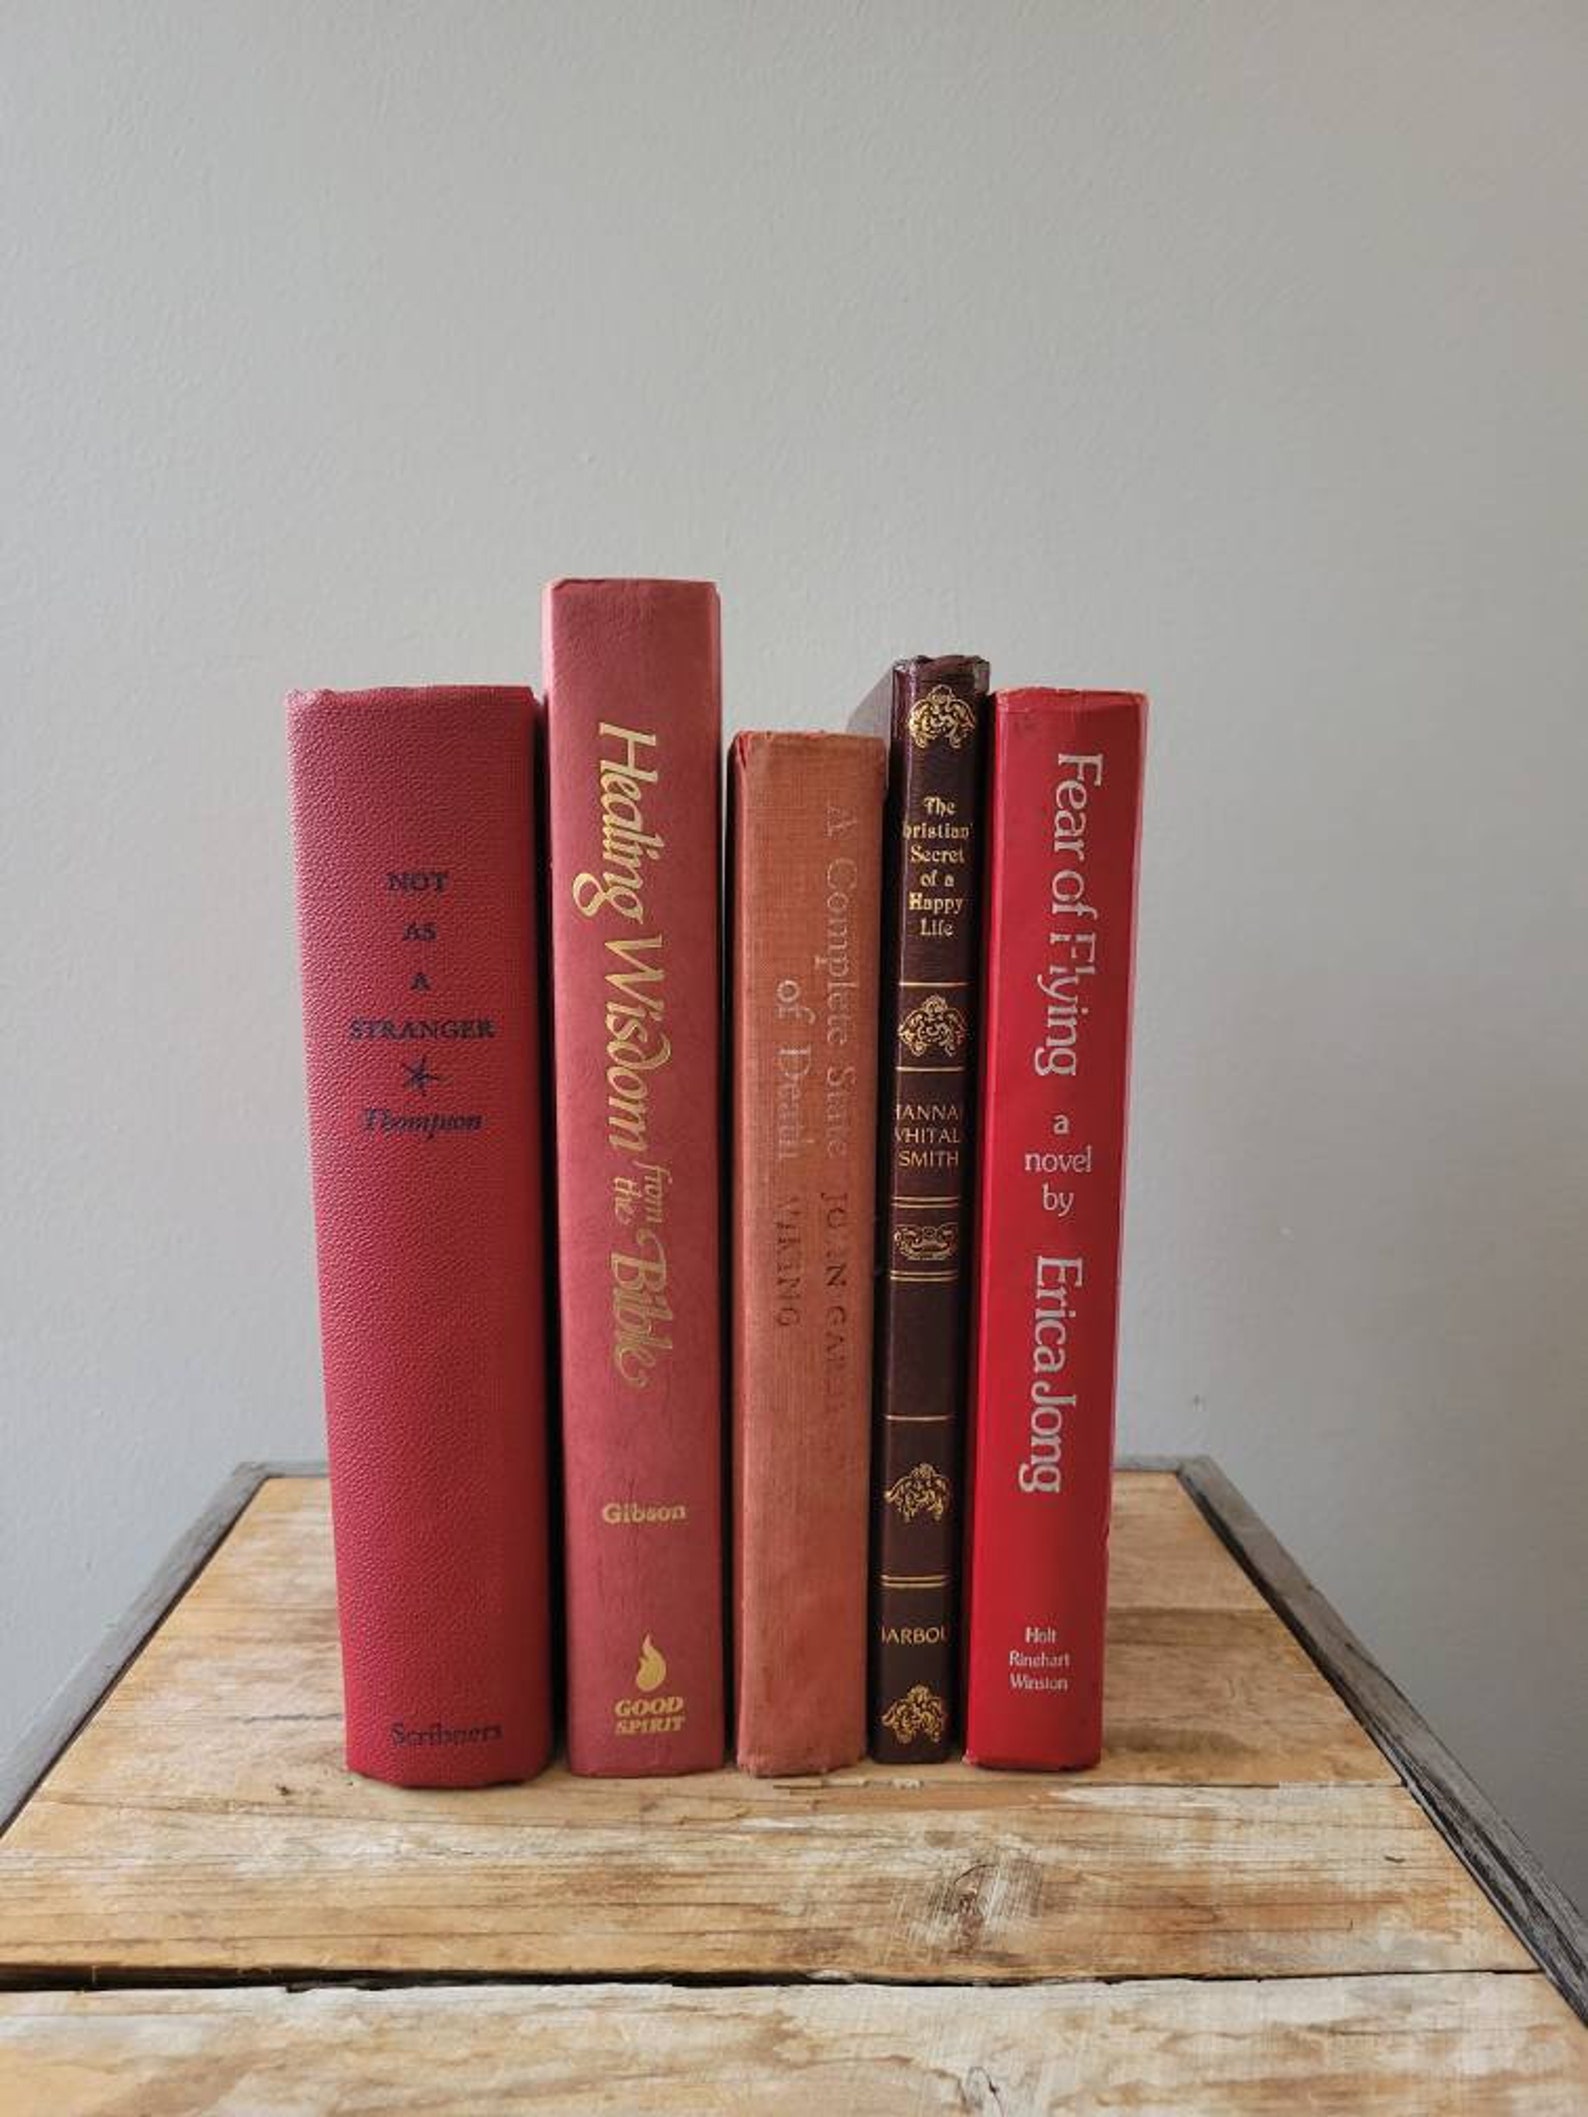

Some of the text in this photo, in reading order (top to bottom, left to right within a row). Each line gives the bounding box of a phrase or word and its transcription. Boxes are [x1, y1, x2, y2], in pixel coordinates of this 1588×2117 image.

[922, 795, 958, 818] The
[826, 805, 860, 838] A
[909, 843, 966, 865] Secret
[384, 871, 450, 893] NOT
[919, 868, 956, 888] of a
[907, 891, 965, 915] Happy
[1033, 752, 1104, 1078] Fear of Flying
[403, 921, 438, 942] AS
[919, 918, 954, 937] Life
[813, 857, 861, 1048] Complete
[410, 971, 431, 992] A
[776, 979, 817, 1025] of
[349, 1017, 497, 1041] STRANGER
[571, 721, 674, 1389] Healing Wisdom from the Bible
[362, 1106, 483, 1141] Thompson
[895, 1103, 961, 1122] ANNA
[893, 1126, 962, 1145] HITAL
[1053, 1113, 1070, 1136] a
[897, 1149, 961, 1170] SMITH
[1024, 1146, 1094, 1174] novel
[1042, 1182, 1075, 1218] by
[819, 1191, 850, 1288] JON
[1018, 1254, 1084, 1495] Erica Jong
[602, 1502, 688, 1525] Gibson
[881, 1624, 950, 1646] ARBO
[1024, 1626, 1058, 1645] Holt
[1008, 1649, 1071, 1669] Rinehart
[1009, 1672, 1070, 1692] Winston
[614, 1695, 686, 1718] GOOD
[614, 1715, 687, 1736] SPIRIT
